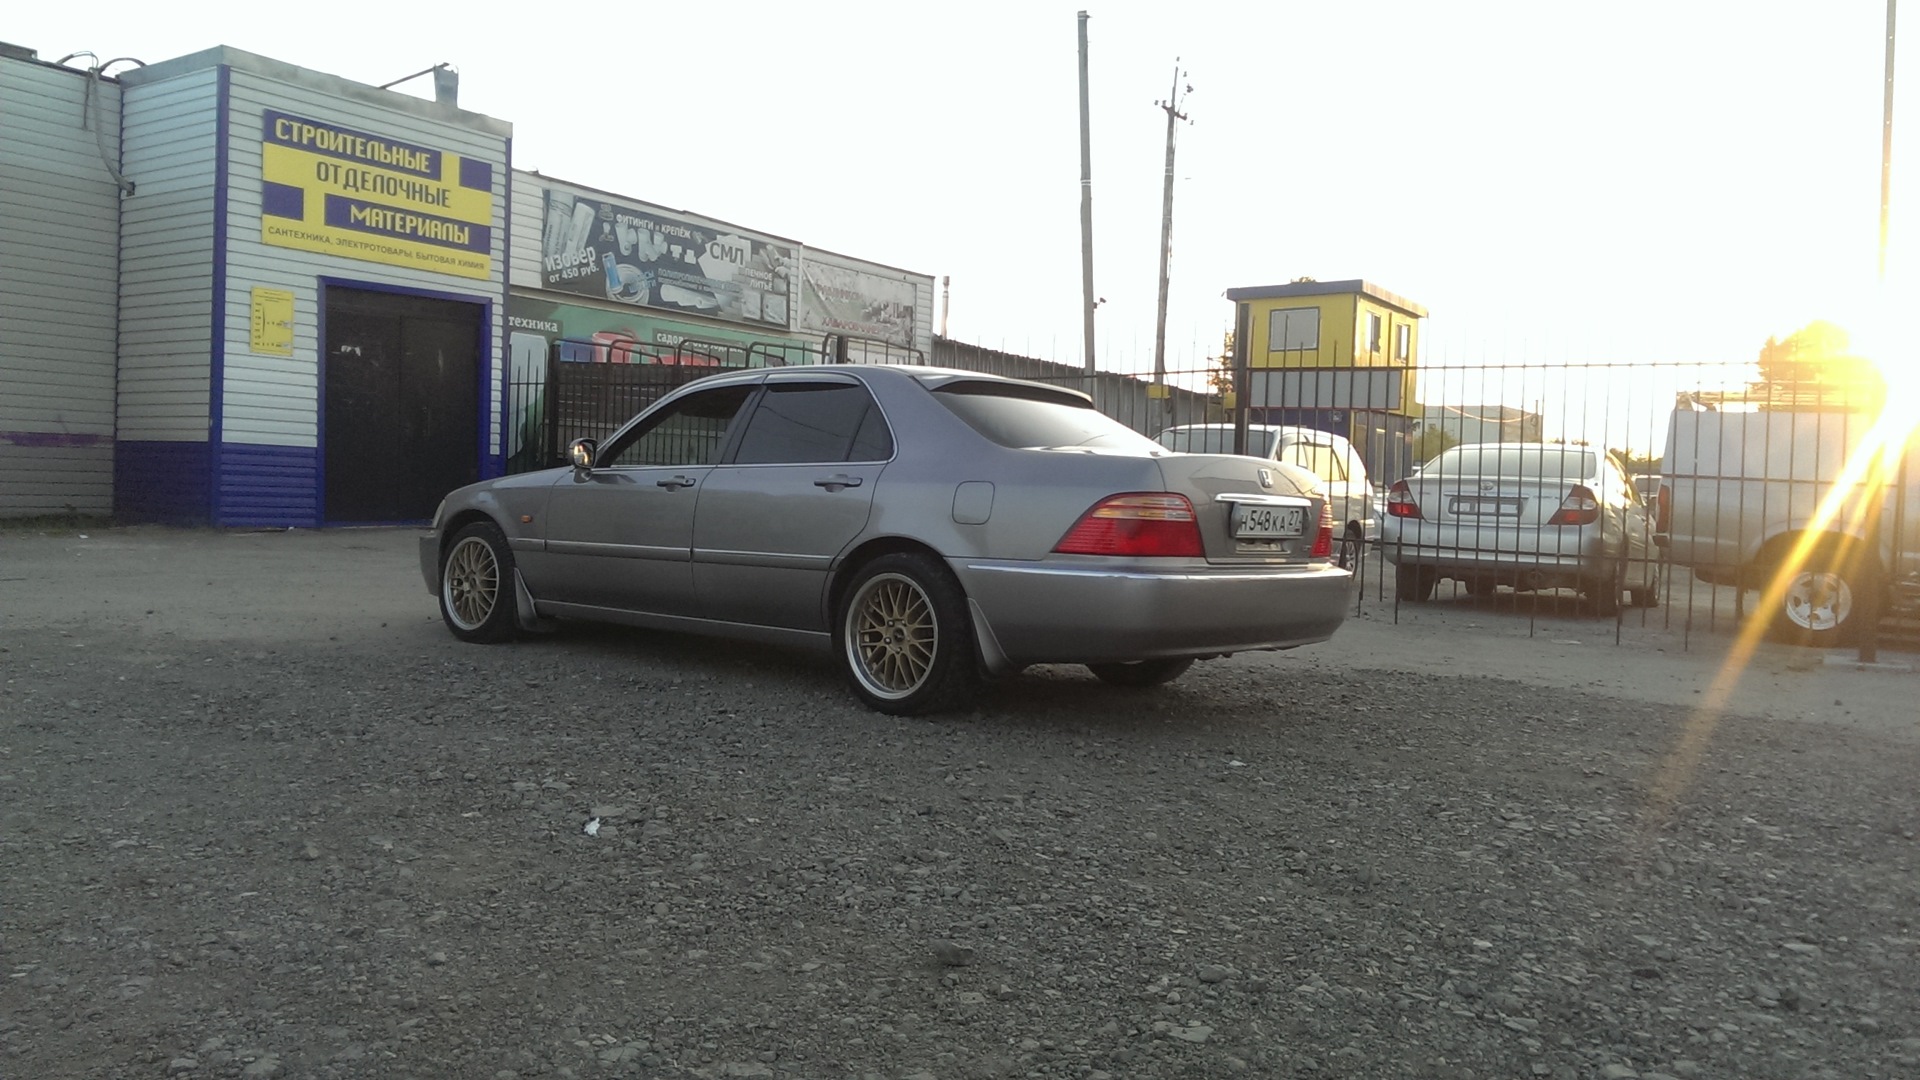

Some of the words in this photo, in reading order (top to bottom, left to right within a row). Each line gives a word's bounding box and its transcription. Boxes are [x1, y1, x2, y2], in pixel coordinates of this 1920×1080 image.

[275, 118, 431, 174] СТРОИТЕЛЬНЫЕ
[316, 161, 452, 209] ОТДЕЛОЧНЫЕ
[350, 204, 470, 245] МАТЕРИАЛЫ
[616, 213, 654, 231] ФИТИНГИ
[268, 225, 333, 246] САНТЕХНИКА,
[415, 251, 457, 266] БЫТОВАЯ
[457, 258, 485, 271] ХИМИЯ
[709, 241, 745, 266] СМЛ
[562, 268, 579, 279] 450
[508, 316, 559, 333] техника
